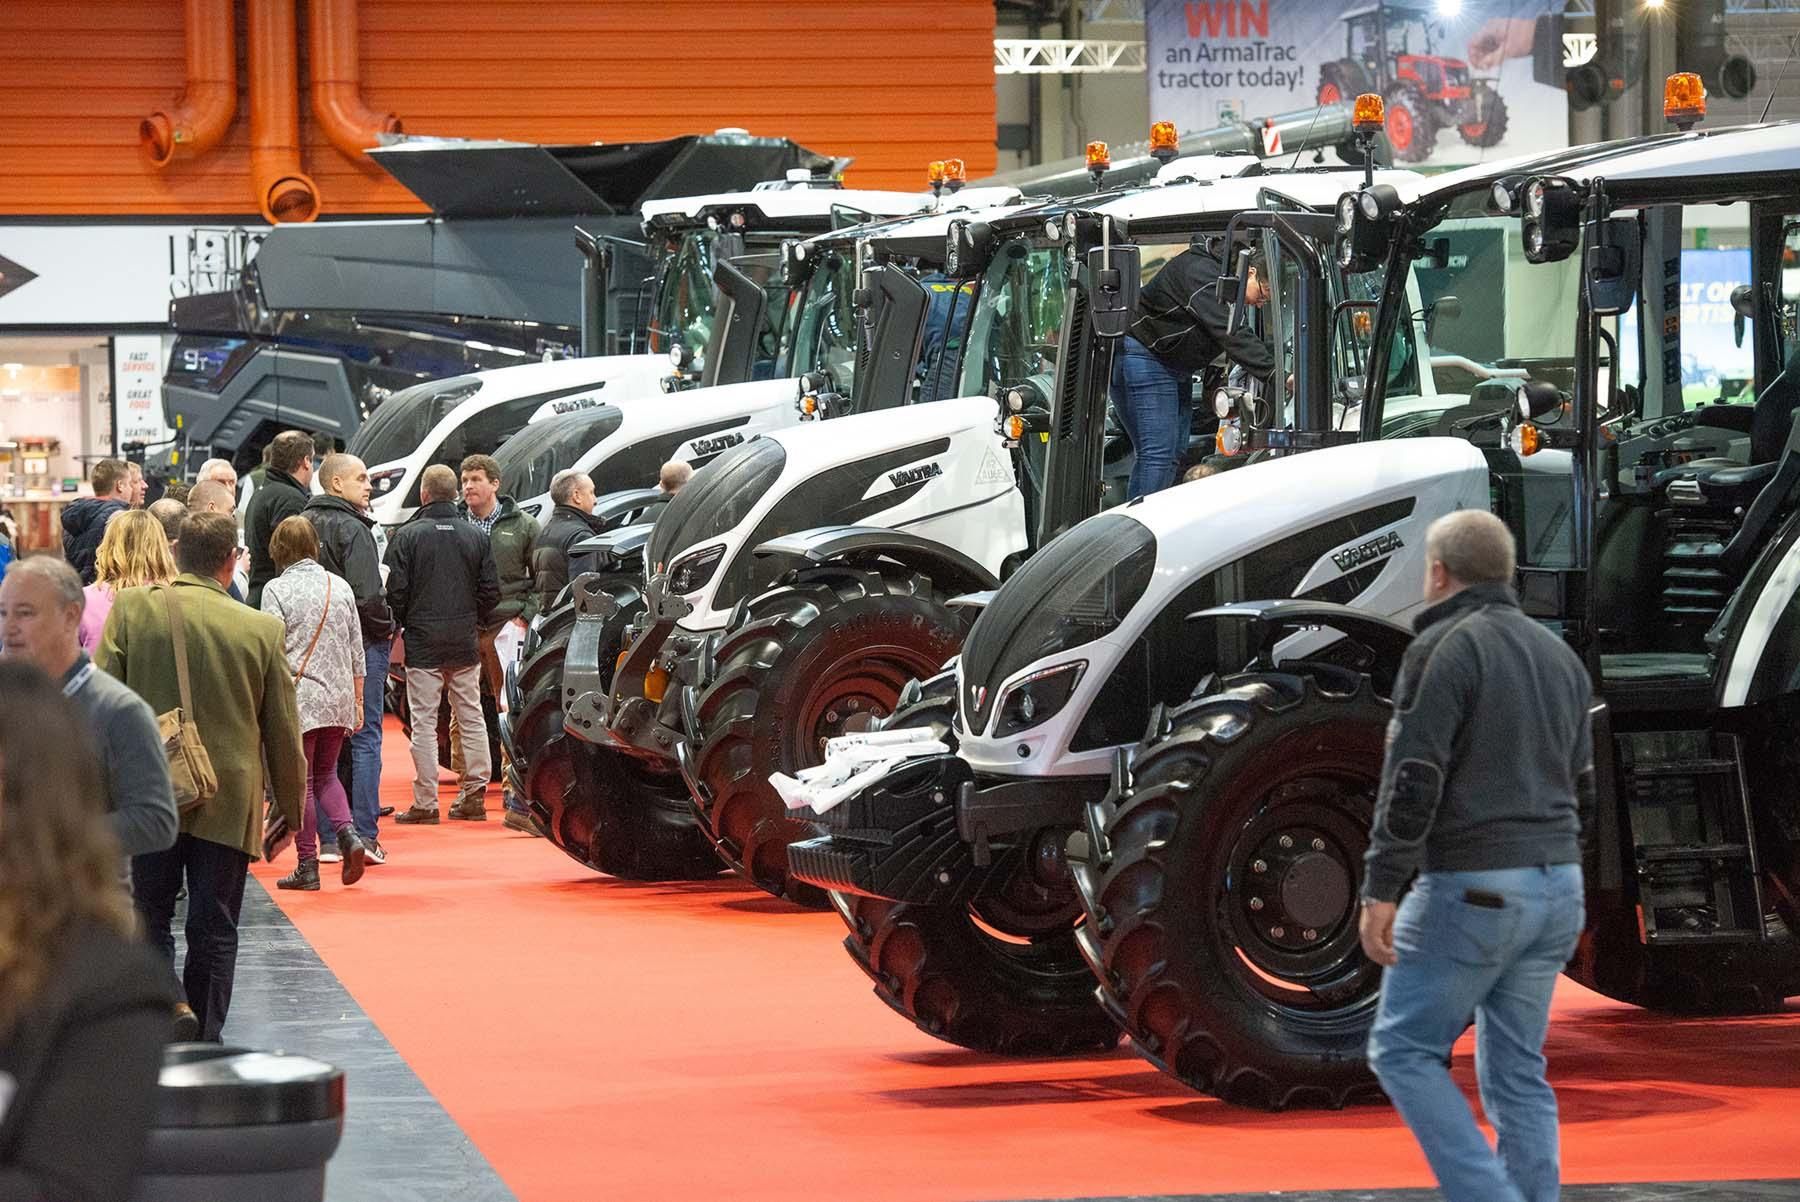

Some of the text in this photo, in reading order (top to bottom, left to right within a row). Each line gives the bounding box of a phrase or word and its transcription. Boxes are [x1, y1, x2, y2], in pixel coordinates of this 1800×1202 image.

[1184, 0, 1268, 38] WIN
[1166, 42, 1297, 63] an ArmaTrac
[1158, 65, 1304, 92] tractor today!
[129, 352, 149, 361] FAST
[127, 390, 152, 399] GREAT
[690, 432, 745, 456] VALTRA
[888, 462, 943, 488] VALTRA
[1331, 531, 1405, 573] VALTRA
